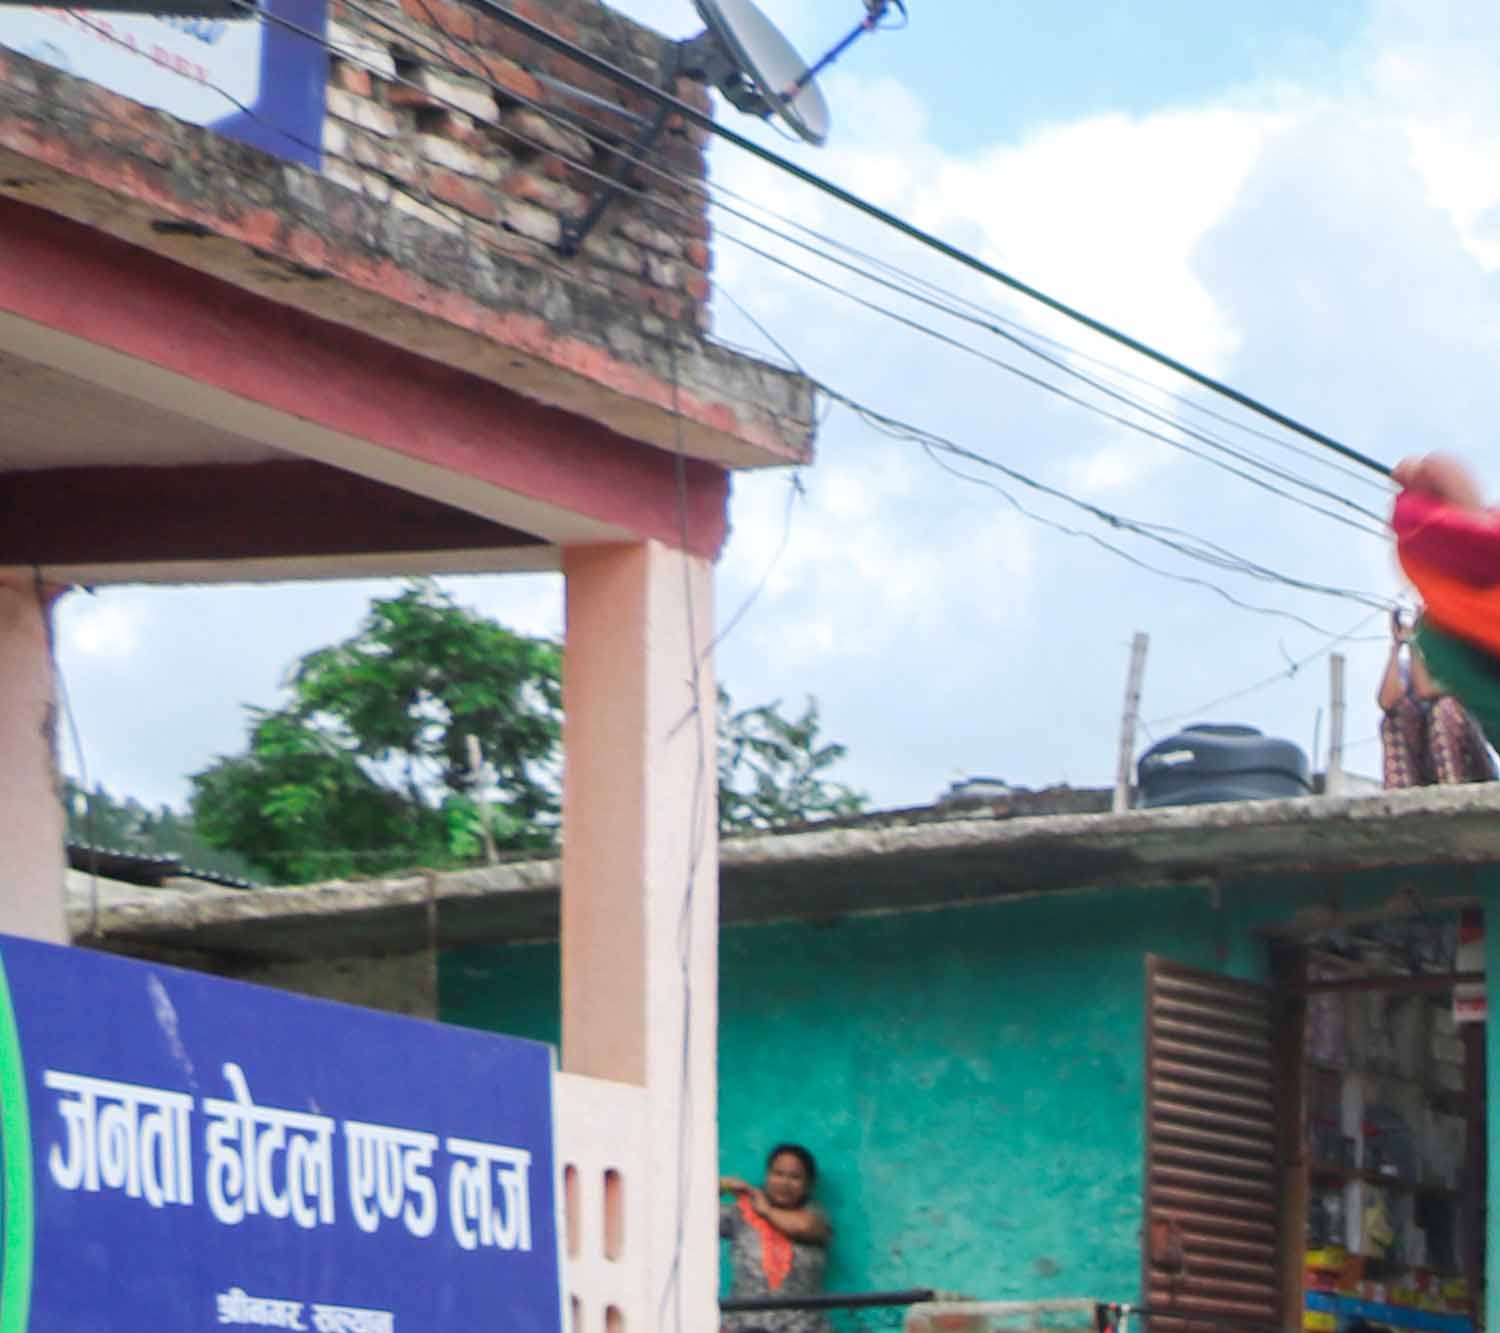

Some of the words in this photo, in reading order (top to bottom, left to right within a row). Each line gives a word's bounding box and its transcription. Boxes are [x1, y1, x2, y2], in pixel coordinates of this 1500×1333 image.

[44, 1068, 195, 1208] जनता
[203, 1062, 336, 1229] होटल
[342, 1120, 440, 1239] एण्ड
[446, 1137, 532, 1252] लज
